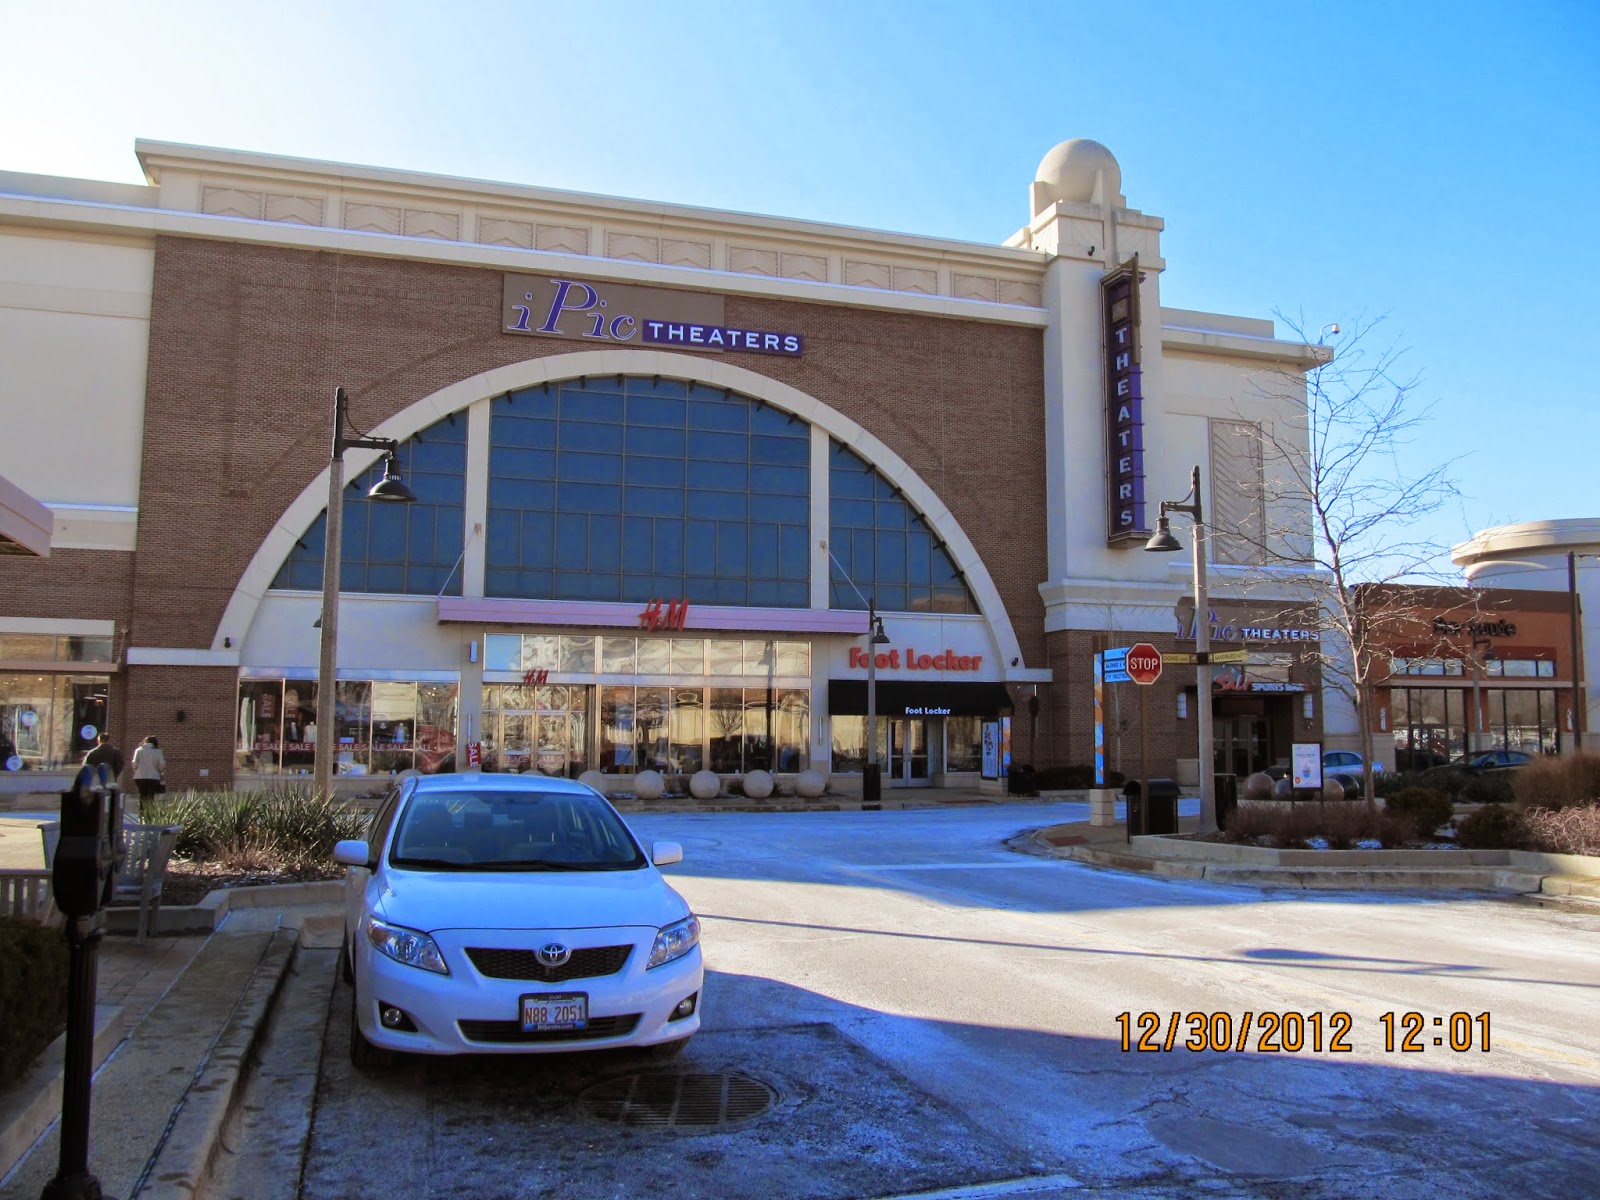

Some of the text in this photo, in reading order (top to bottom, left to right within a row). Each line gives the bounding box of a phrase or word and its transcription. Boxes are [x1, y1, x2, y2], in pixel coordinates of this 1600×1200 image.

[649, 322, 799, 352] THEATERS
[1115, 327, 1133, 526] THEATERS
[639, 598, 689, 632] H&M
[1242, 628, 1319, 640] THEATERS
[849, 647, 982, 671] Foot Locker
[1130, 657, 1158, 670] STOP
[523, 669, 549, 684] H&M
[1251, 682, 1284, 691] SPORTS
[925, 707, 950, 715] Locker
[289, 743, 311, 751] SALE
[339, 743, 360, 751] SALE
[387, 743, 408, 751] SALE
[469, 743, 479, 767] SALE
[525, 1005, 584, 1023] N88 2051
